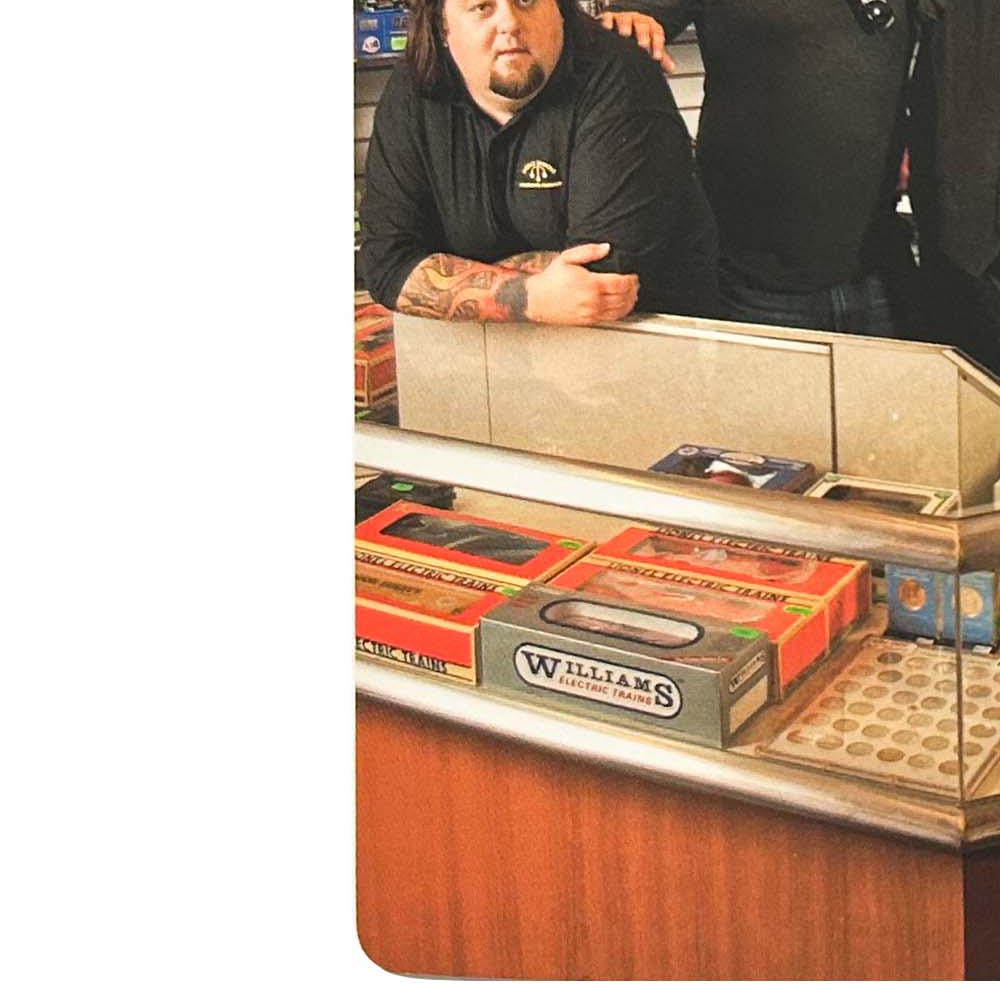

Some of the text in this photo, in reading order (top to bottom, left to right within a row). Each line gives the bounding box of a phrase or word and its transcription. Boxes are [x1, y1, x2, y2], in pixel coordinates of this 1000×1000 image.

[735, 584, 789, 605] TRAINS
[521, 649, 674, 708] WILLIAMS
[558, 675, 652, 706] ELECTRIC TRAINS
